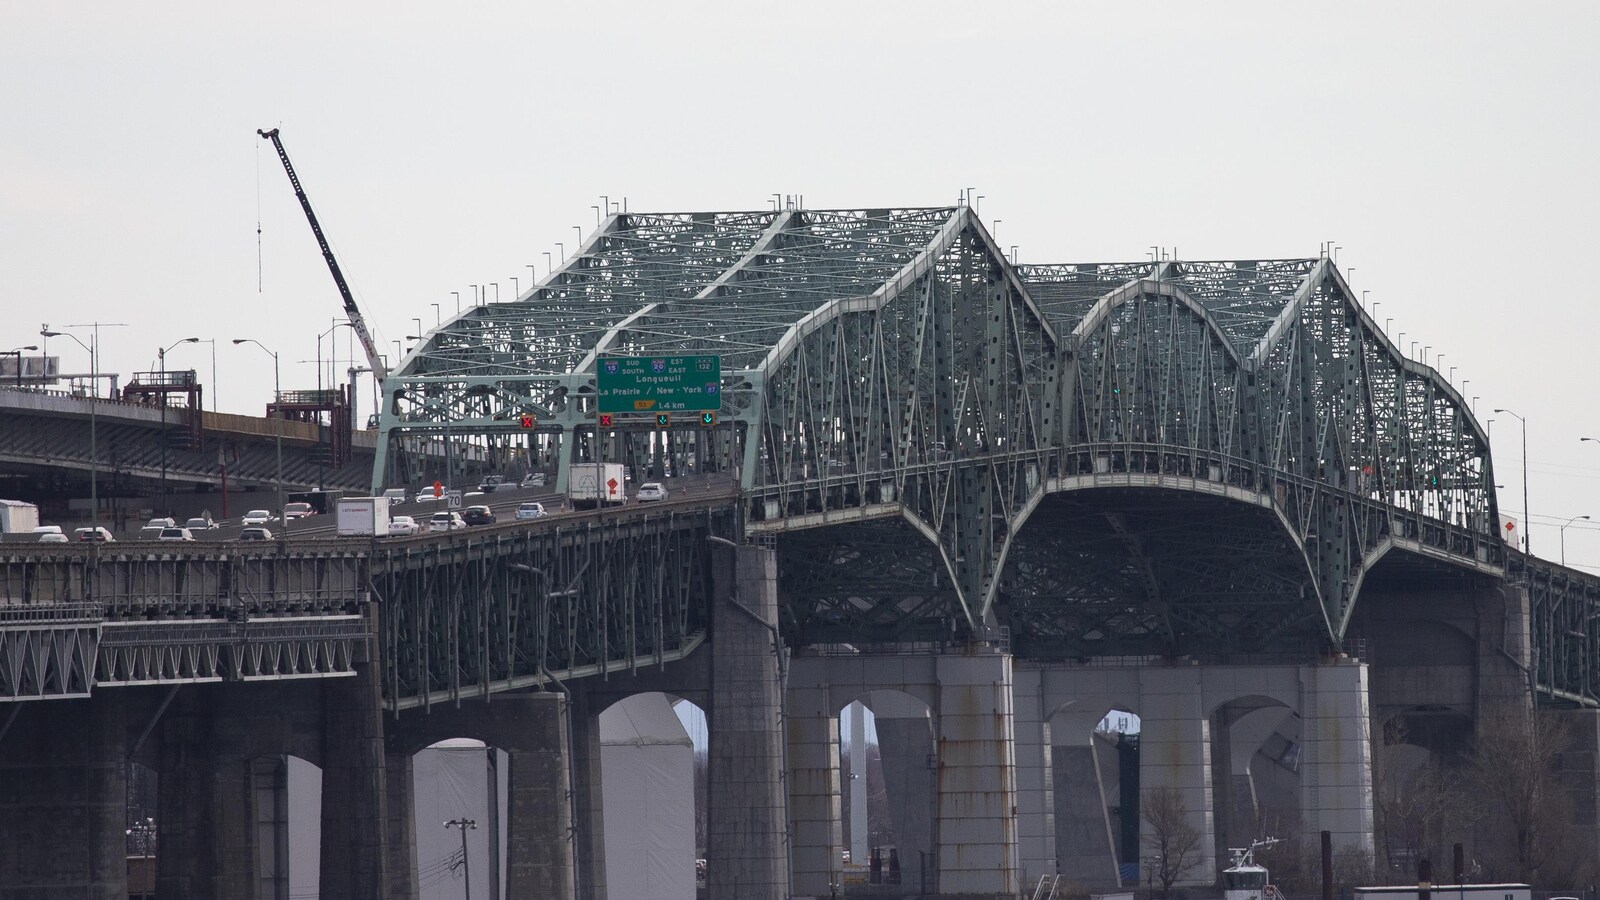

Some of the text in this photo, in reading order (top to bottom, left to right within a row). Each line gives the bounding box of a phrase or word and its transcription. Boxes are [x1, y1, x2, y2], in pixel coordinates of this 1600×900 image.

[636, 375, 681, 384] Longueuil
[612, 388, 641, 396] Prairie
[449, 496, 460, 506] 70
